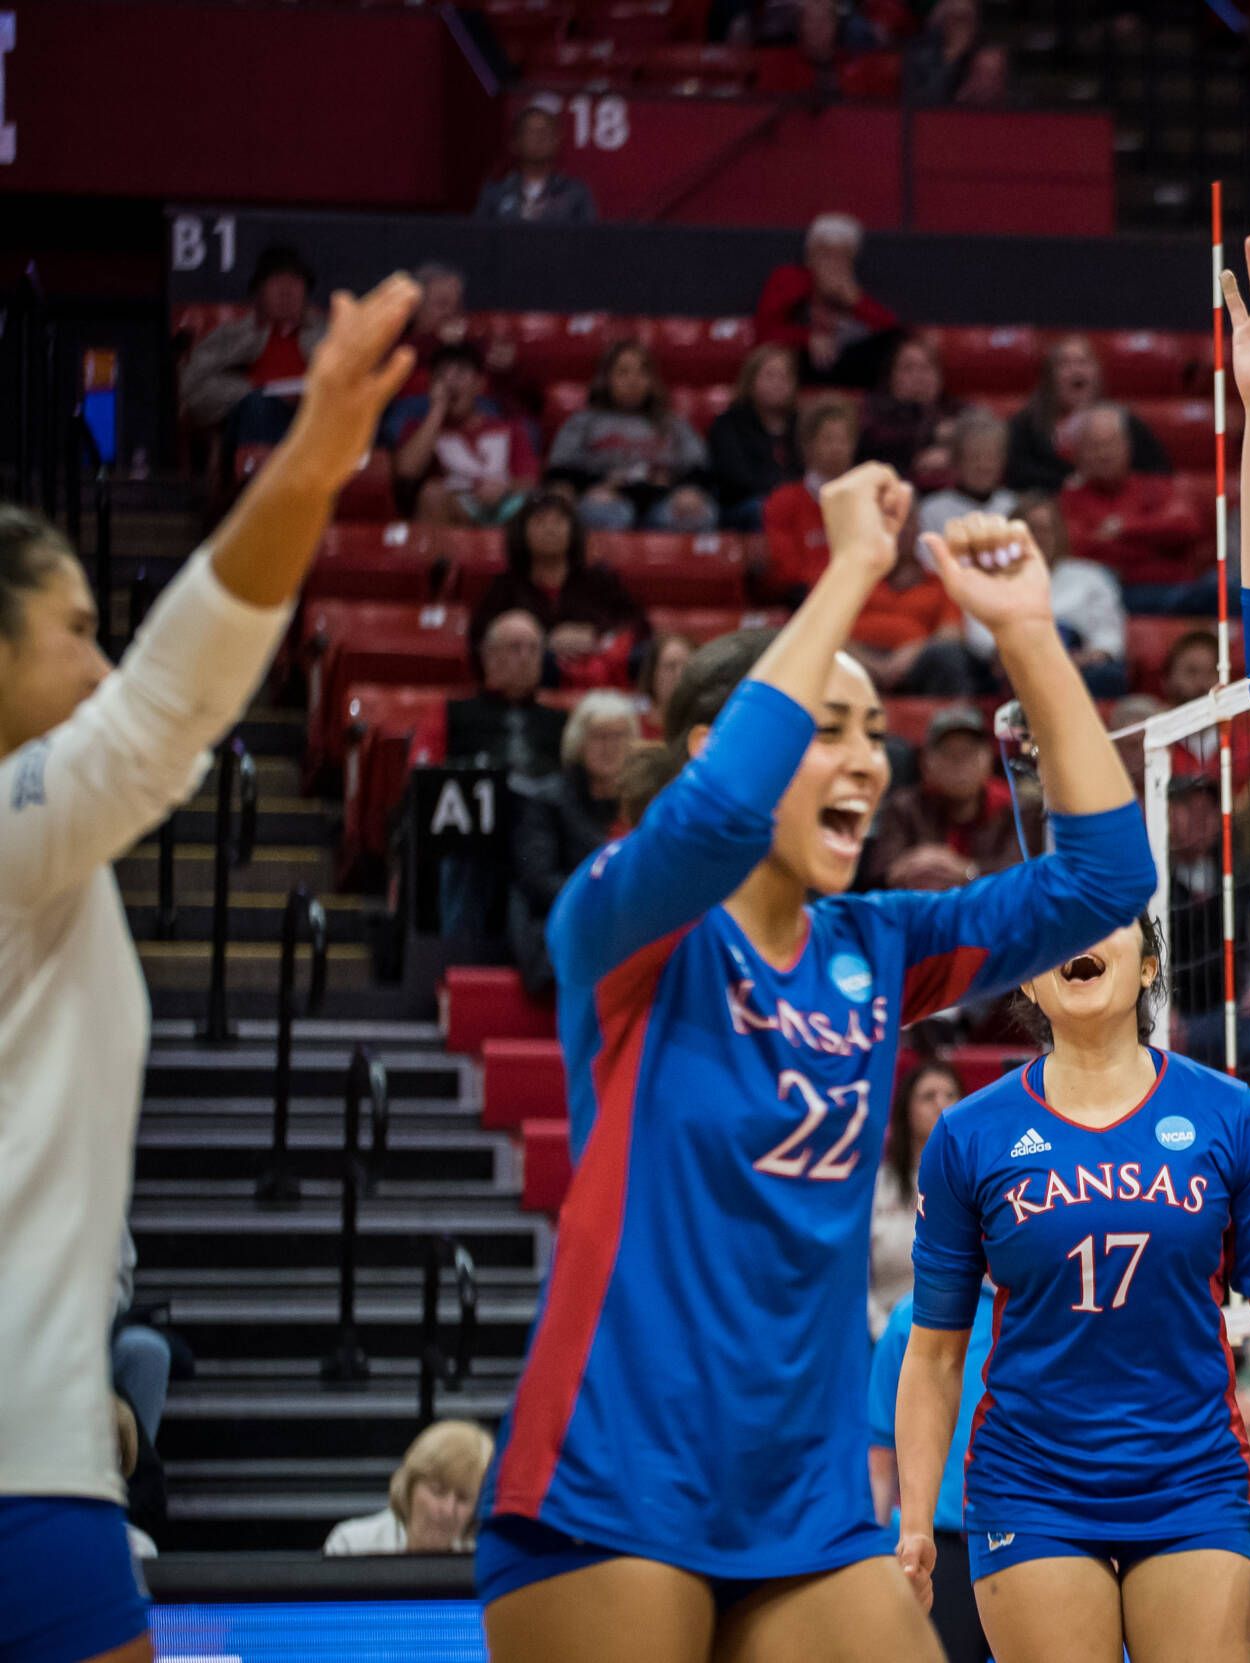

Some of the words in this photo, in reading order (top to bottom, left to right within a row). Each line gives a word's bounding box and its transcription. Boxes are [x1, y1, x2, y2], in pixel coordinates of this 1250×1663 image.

[171, 214, 237, 272] B1
[430, 778, 496, 835] A1
[752, 1068, 870, 1182] 22
[1010, 1141, 1052, 1158] adidas
[1161, 1130, 1195, 1143] NCAA
[1004, 1162, 1208, 1225] KANSAS
[1066, 1231, 1151, 1313] 17
